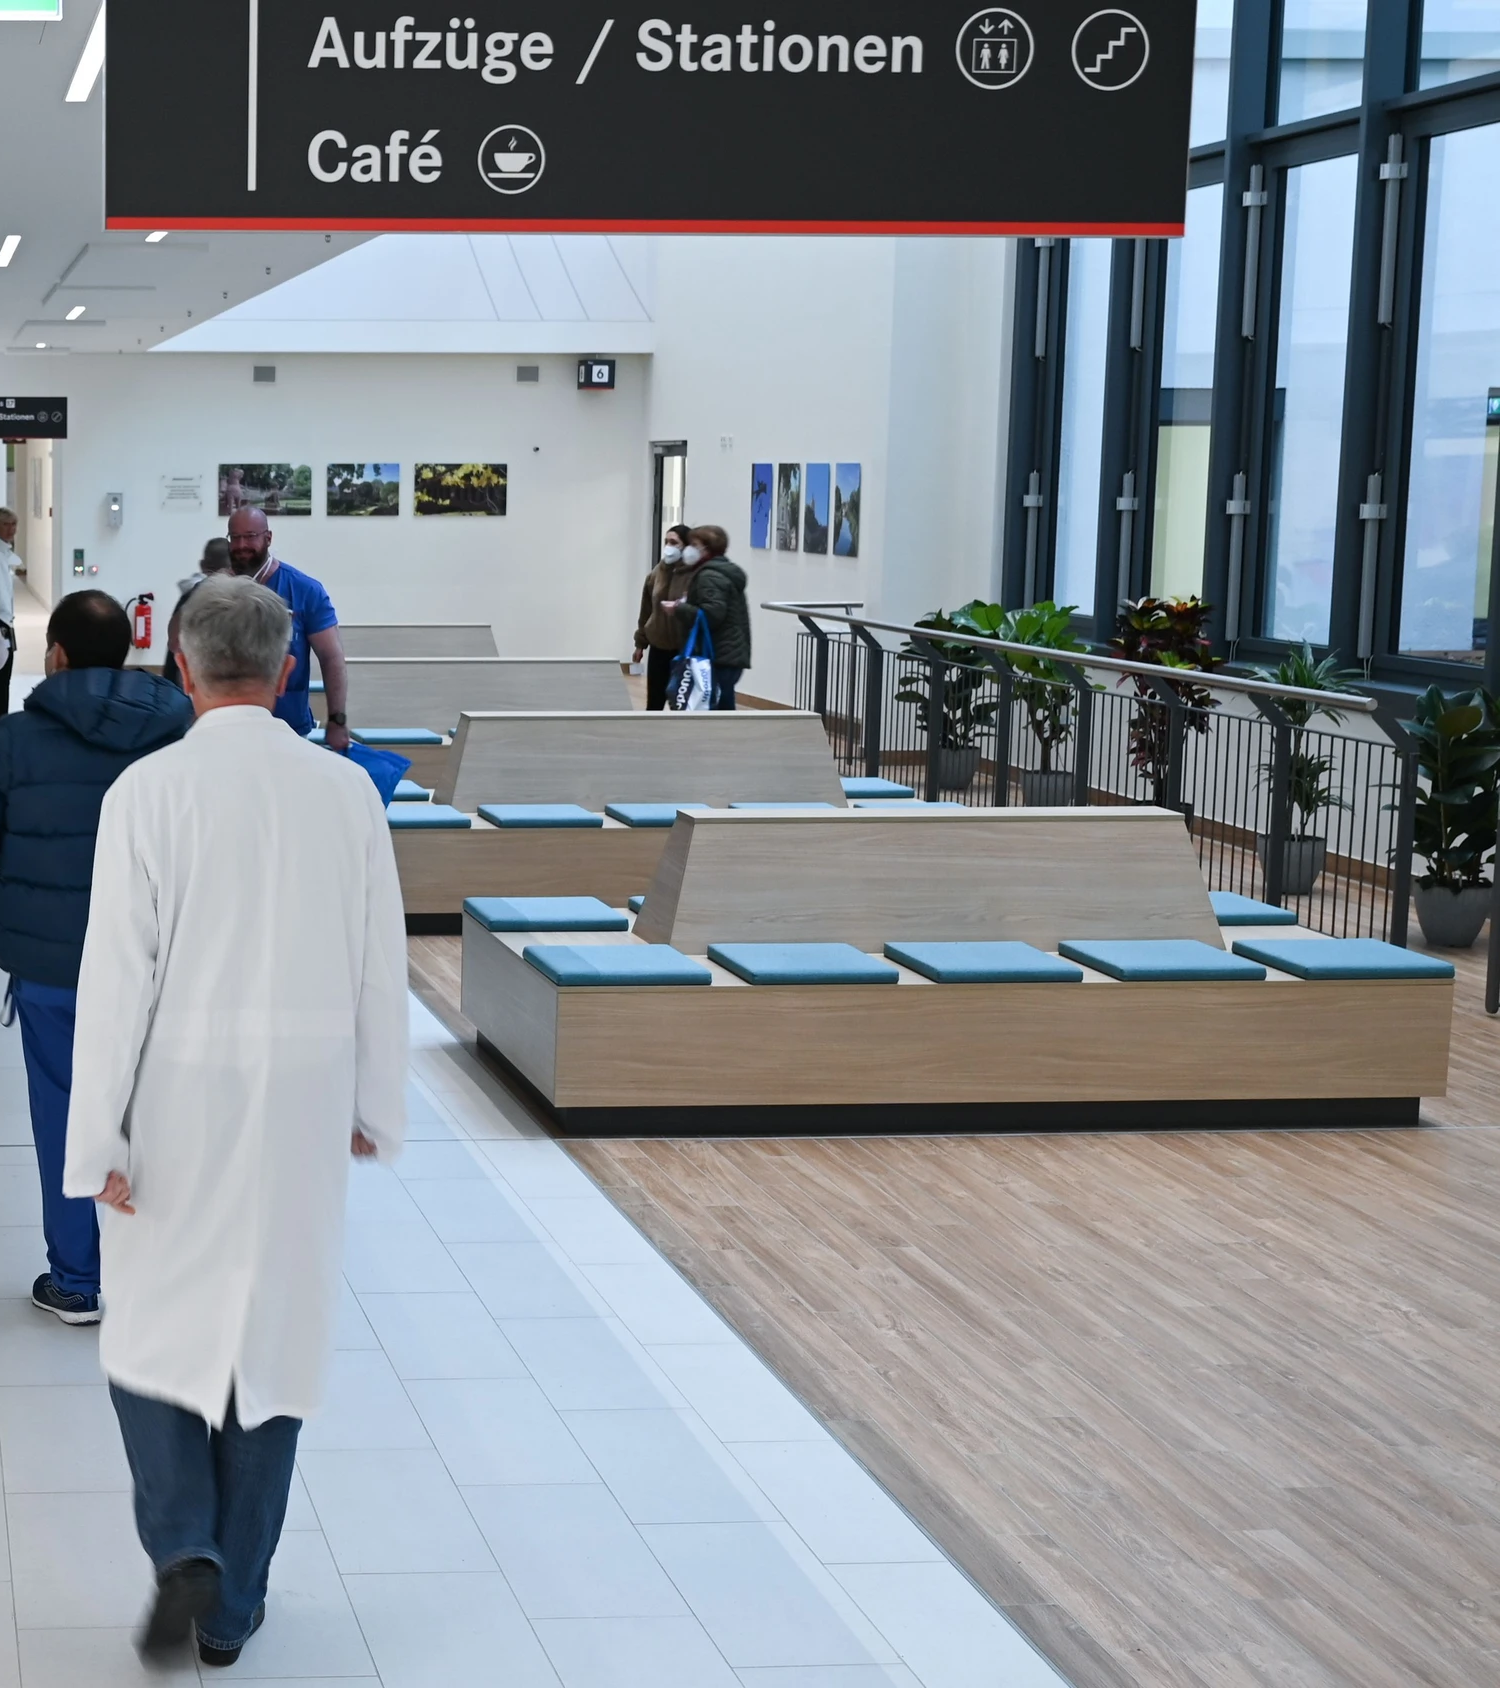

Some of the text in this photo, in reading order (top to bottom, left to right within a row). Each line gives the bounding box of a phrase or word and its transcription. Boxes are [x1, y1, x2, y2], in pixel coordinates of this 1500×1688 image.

[307, 15, 924, 85] Aufzüge / Stationen
[307, 128, 443, 184] Café
[596, 368, 604, 379] 6
